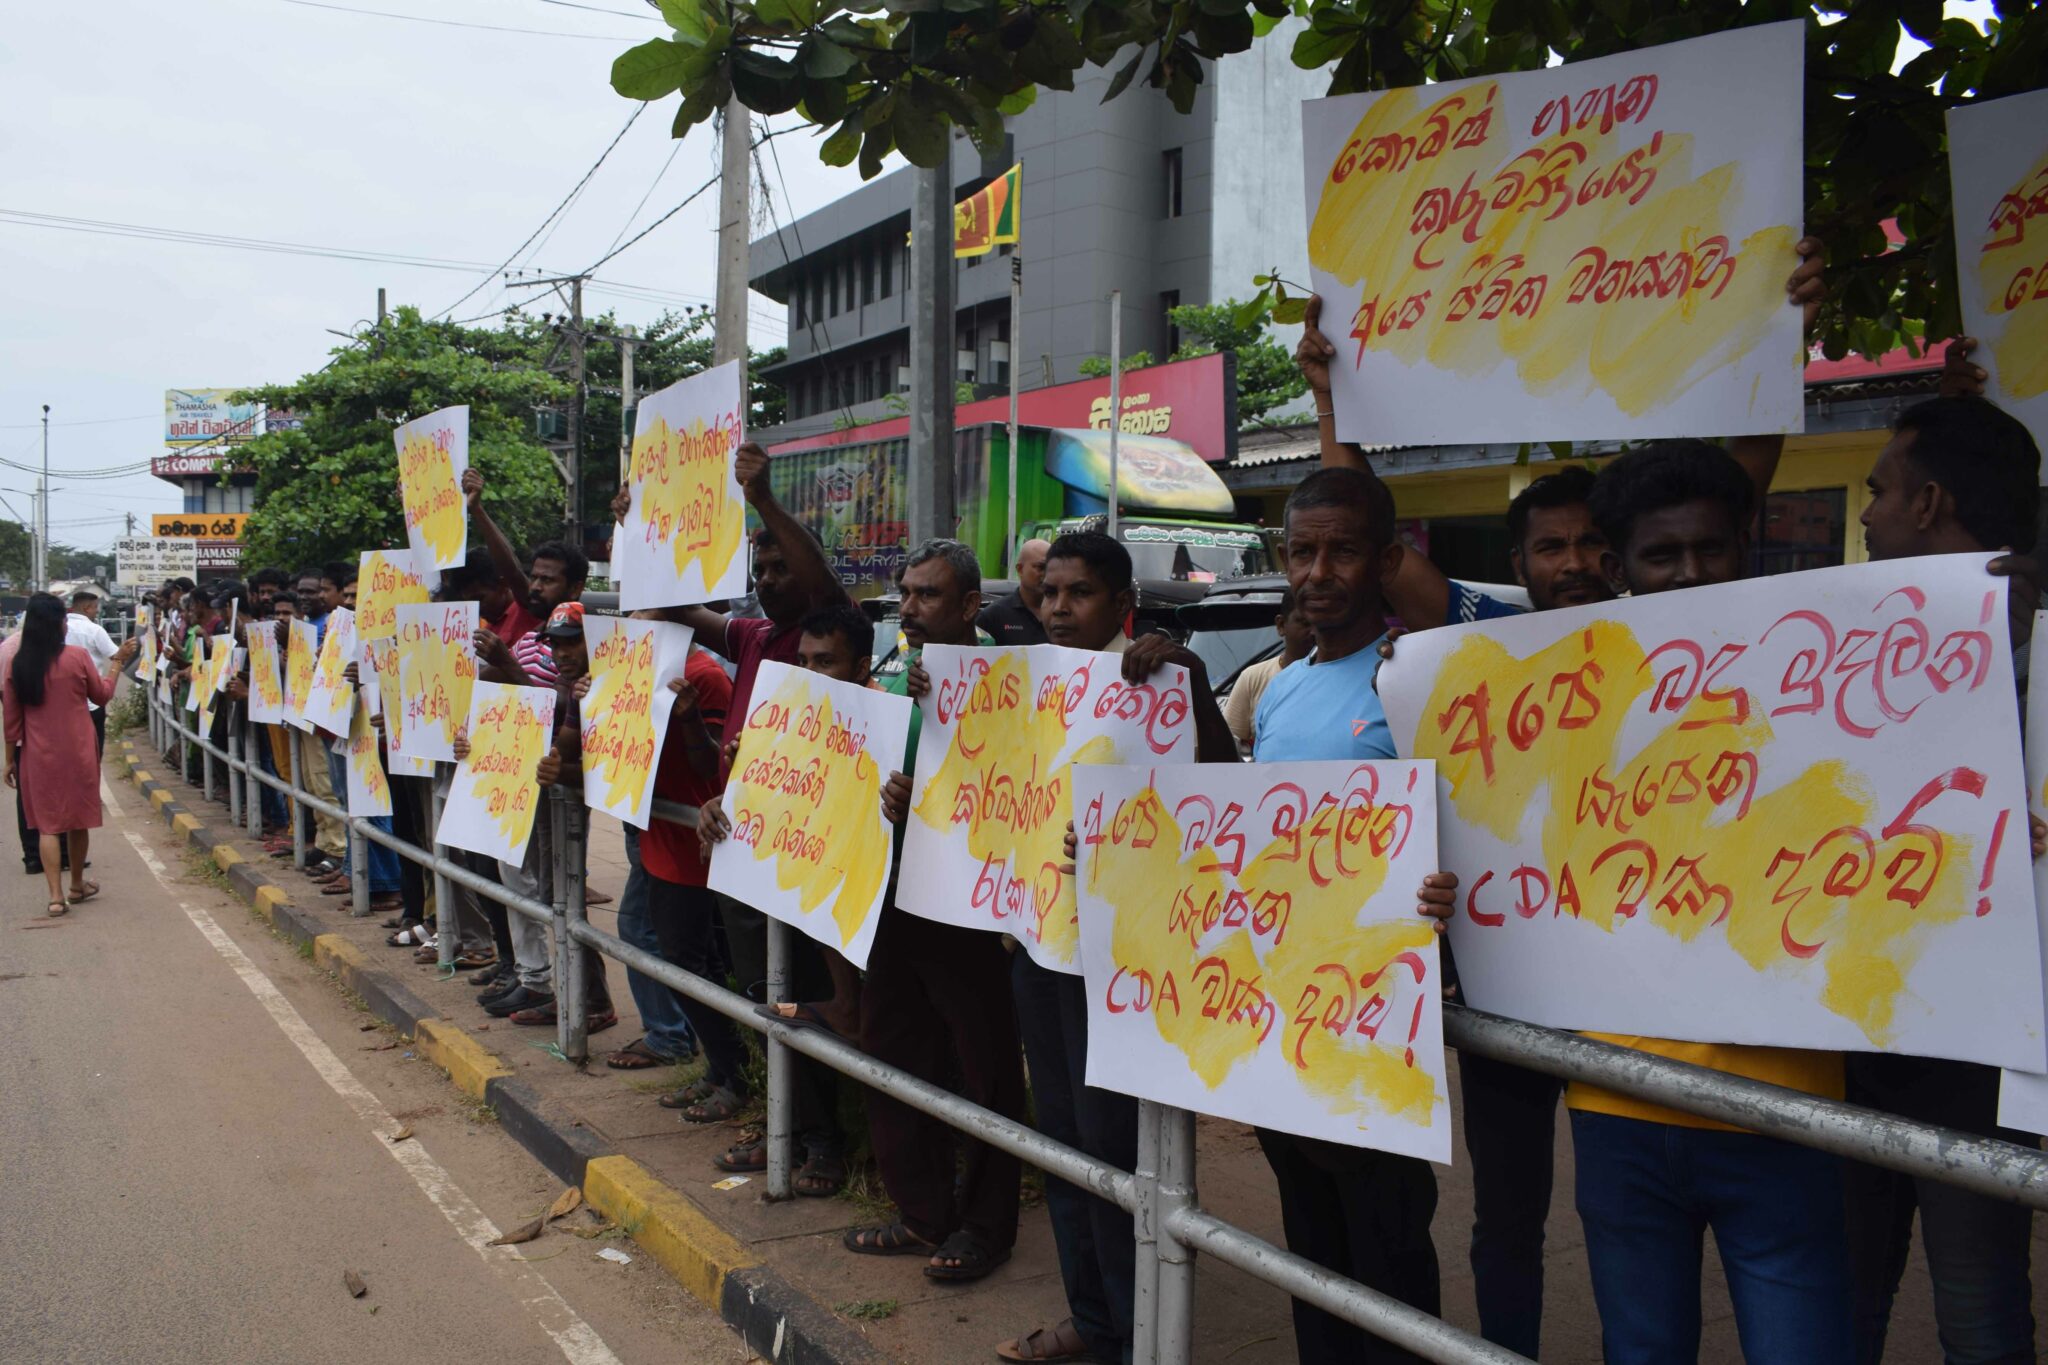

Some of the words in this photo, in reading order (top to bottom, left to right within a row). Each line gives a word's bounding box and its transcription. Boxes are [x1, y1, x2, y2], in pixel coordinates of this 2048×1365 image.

[175, 403, 217, 411] THAMASHA
[197, 547, 242, 561] HAMASH
[748, 700, 789, 733] CDA
[1439, 628, 1604, 787] අපේ
[1084, 768, 1160, 884] අපේ
[1575, 751, 1758, 835] යැපෙන
[1168, 884, 1292, 951] යැපෙන
[1467, 861, 1583, 927] CDA
[1106, 964, 1181, 1018] CDA
